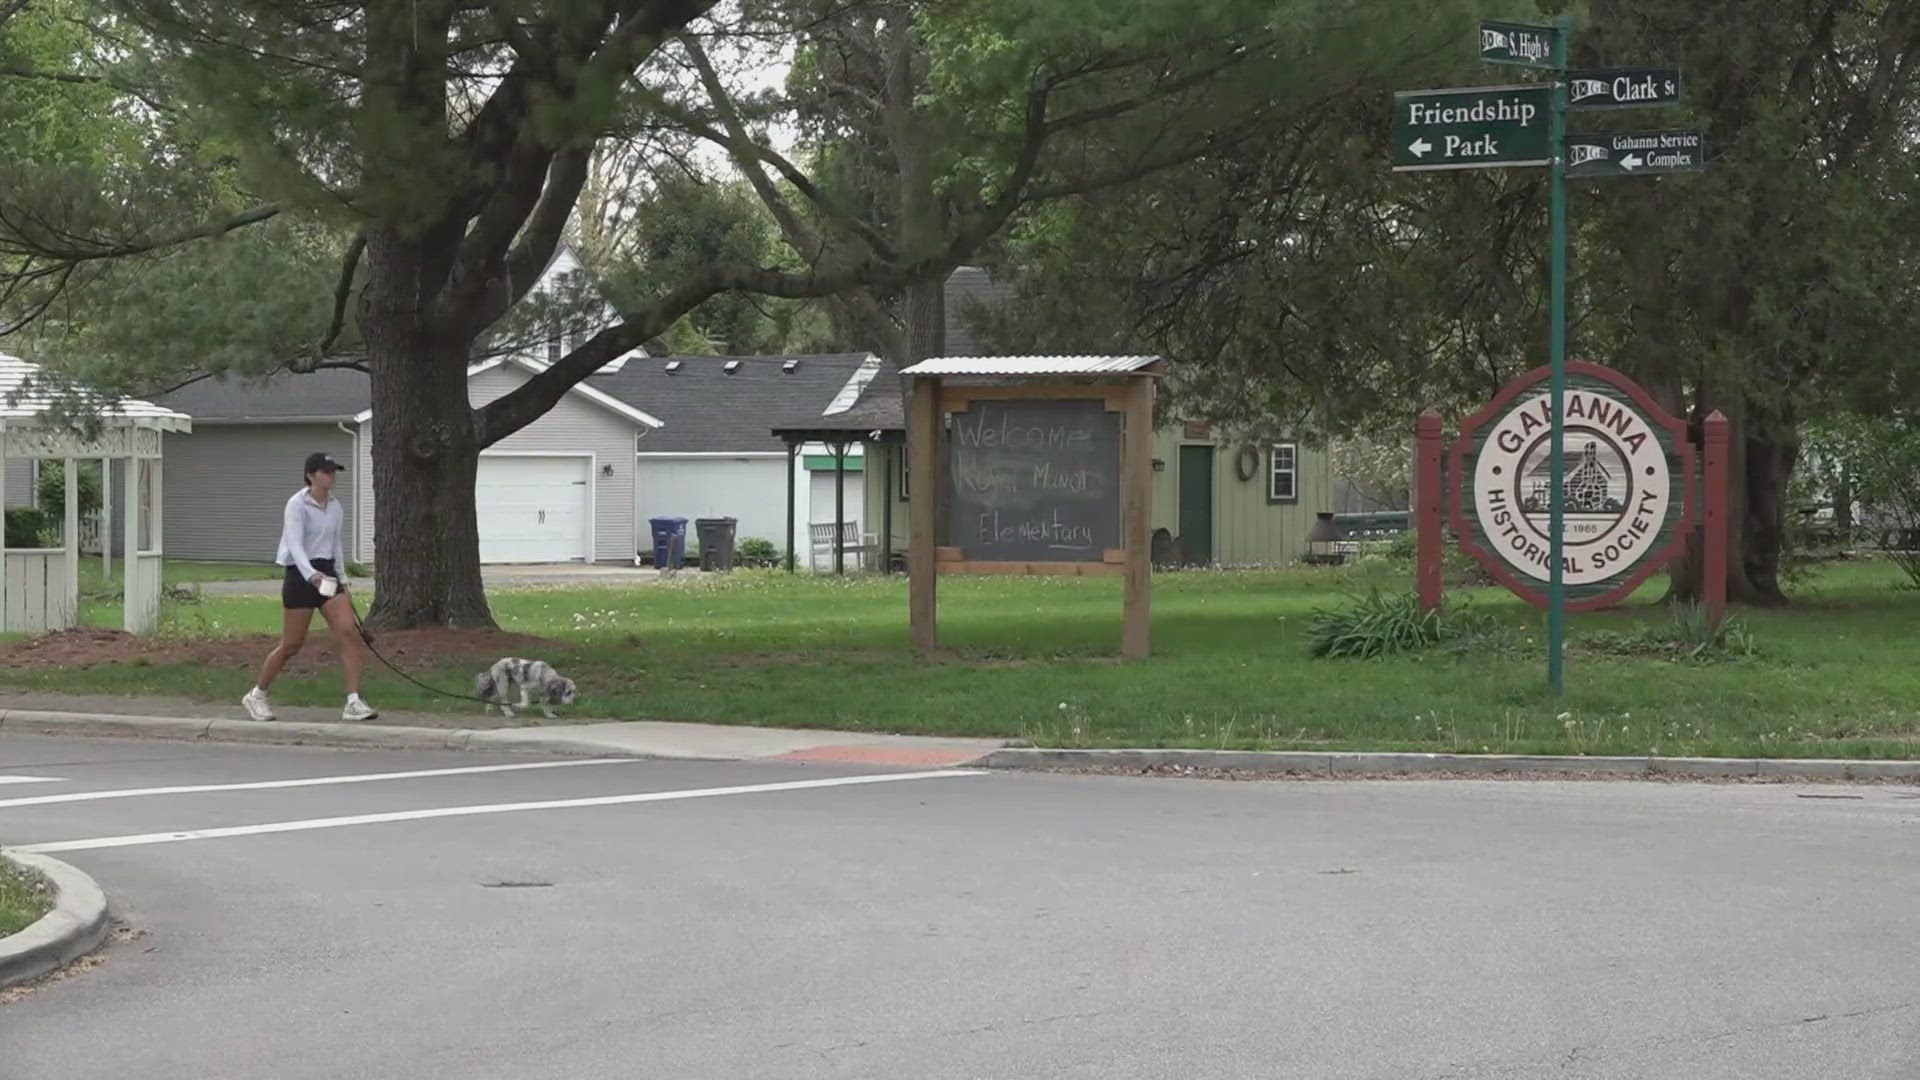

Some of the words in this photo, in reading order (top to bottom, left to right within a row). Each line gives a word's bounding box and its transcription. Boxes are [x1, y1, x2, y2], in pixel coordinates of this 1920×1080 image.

[1508, 31, 1518, 56] S.
[1519, 32, 1542, 62] High
[1612, 75, 1658, 102] Clark
[1664, 81, 1675, 96] St
[1408, 98, 1535, 127] Friendship
[1444, 134, 1498, 157] Park
[1612, 135, 1660, 151] Gahanna
[1660, 132, 1699, 149] Service
[1646, 150, 1692, 168] Complex
[1573, 523, 1597, 533] 1965
[1591, 489, 1658, 570] SOCIETY
